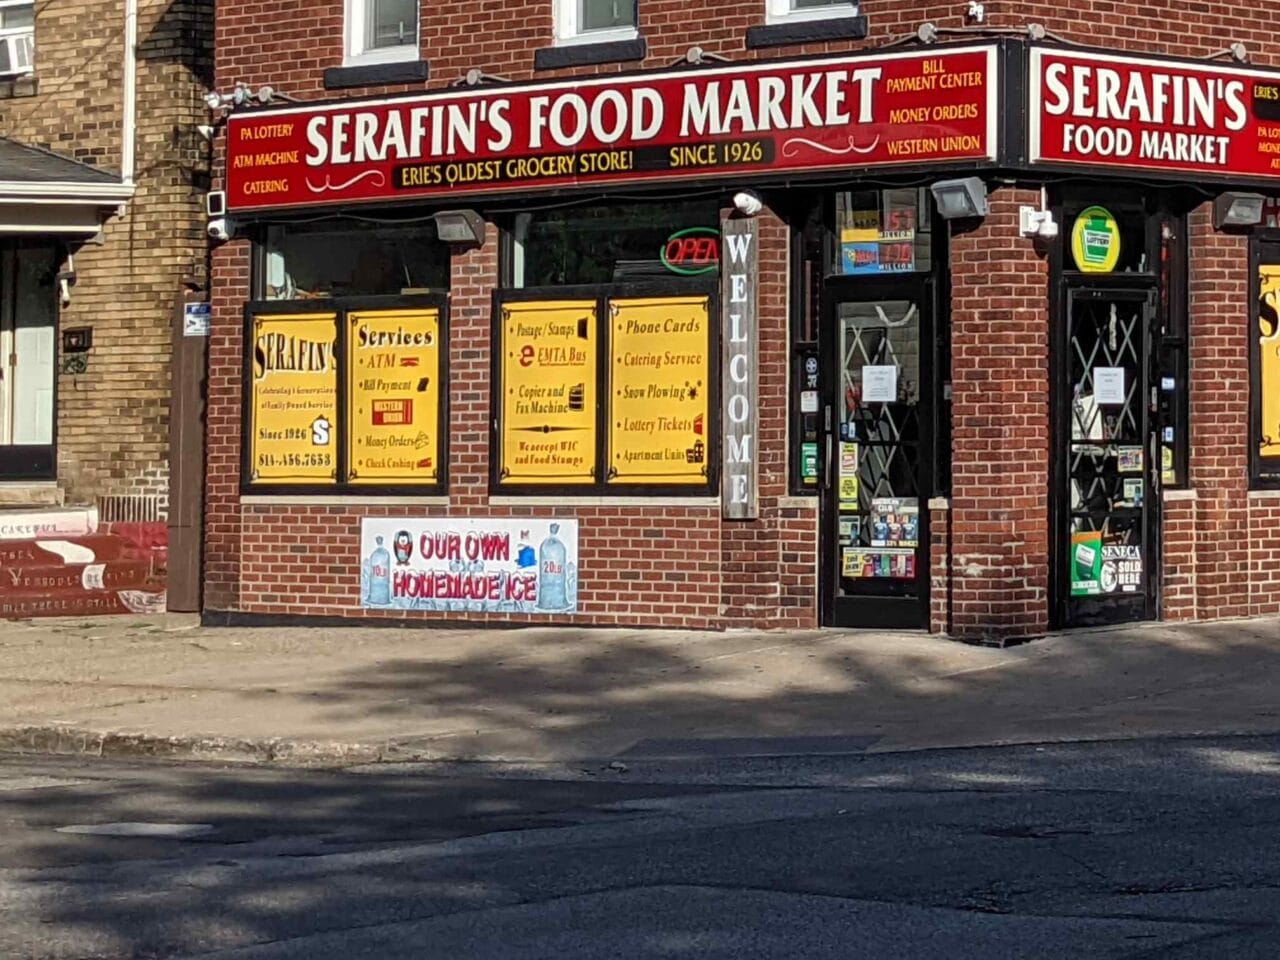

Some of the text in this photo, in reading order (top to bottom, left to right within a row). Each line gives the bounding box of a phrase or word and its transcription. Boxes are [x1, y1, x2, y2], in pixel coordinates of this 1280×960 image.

[923, 59, 945, 75] BILL
[886, 72, 982, 93] PAYMENT CENTER
[1044, 62, 1248, 132] SERAFIN'S
[305, 67, 883, 167] SERAFIN'S FOOD MARKET
[889, 104, 979, 124] MONEY ORDERS
[240, 123, 295, 140] PA LOTTERY
[887, 135, 981, 156] WESTERN UNION
[1062, 124, 1229, 165] FOOD MARKET
[233, 150, 299, 168] ATM MACHINE
[401, 142, 763, 187] ERIE'S OLDEST GROCERY STORE! SINCE 1926
[243, 179, 289, 194] CATERING
[665, 237, 719, 264] OPEN
[626, 318, 700, 334] Phone Cards
[358, 324, 433, 346] Services
[366, 353, 396, 369] ATM
[569, 346, 587, 362] Bus
[624, 351, 702, 369] Catering Service
[725, 233, 752, 505] WELCOME
[364, 379, 412, 394] Bill Payment
[518, 384, 565, 399] Copier and
[623, 384, 686, 402] Snow Plowing
[515, 398, 569, 415] Fax Machine
[259, 427, 283, 440] Since
[285, 428, 307, 439] 1926
[623, 416, 692, 435] Lottery Tickets
[365, 435, 416, 450] Money Orders
[560, 440, 579, 451] WIC
[551, 454, 584, 467] Stamps
[623, 447, 685, 464] Apartment Units
[420, 529, 510, 562] OUR OWN
[1101, 545, 1141, 559] SENECA
[1118, 561, 1143, 573] SOLD
[392, 569, 537, 602] HOMEMADE ICE
